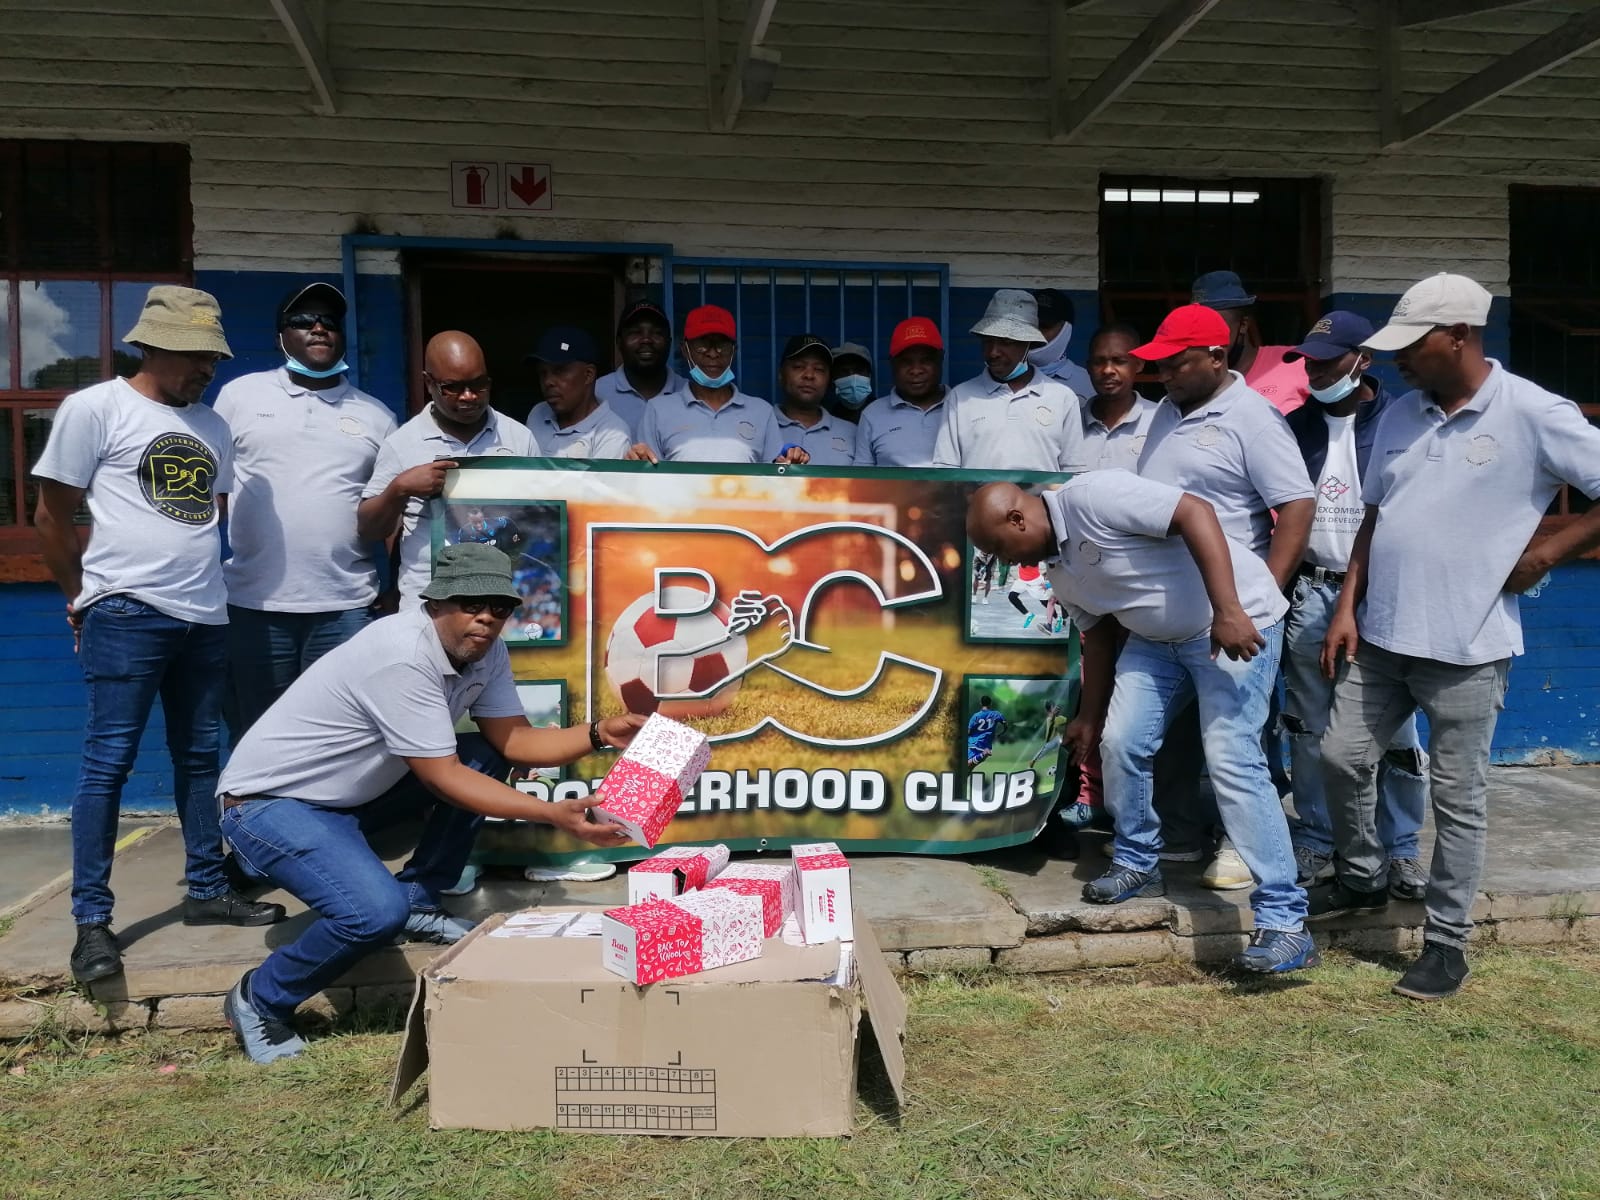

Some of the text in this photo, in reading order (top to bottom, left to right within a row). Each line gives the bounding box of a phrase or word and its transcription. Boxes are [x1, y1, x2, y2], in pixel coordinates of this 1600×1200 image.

[977, 718, 993, 731] 21
[905, 770, 1035, 813] CLUB
[657, 938, 685, 954] BACK TO
[660, 949, 683, 963] SCHOOL
